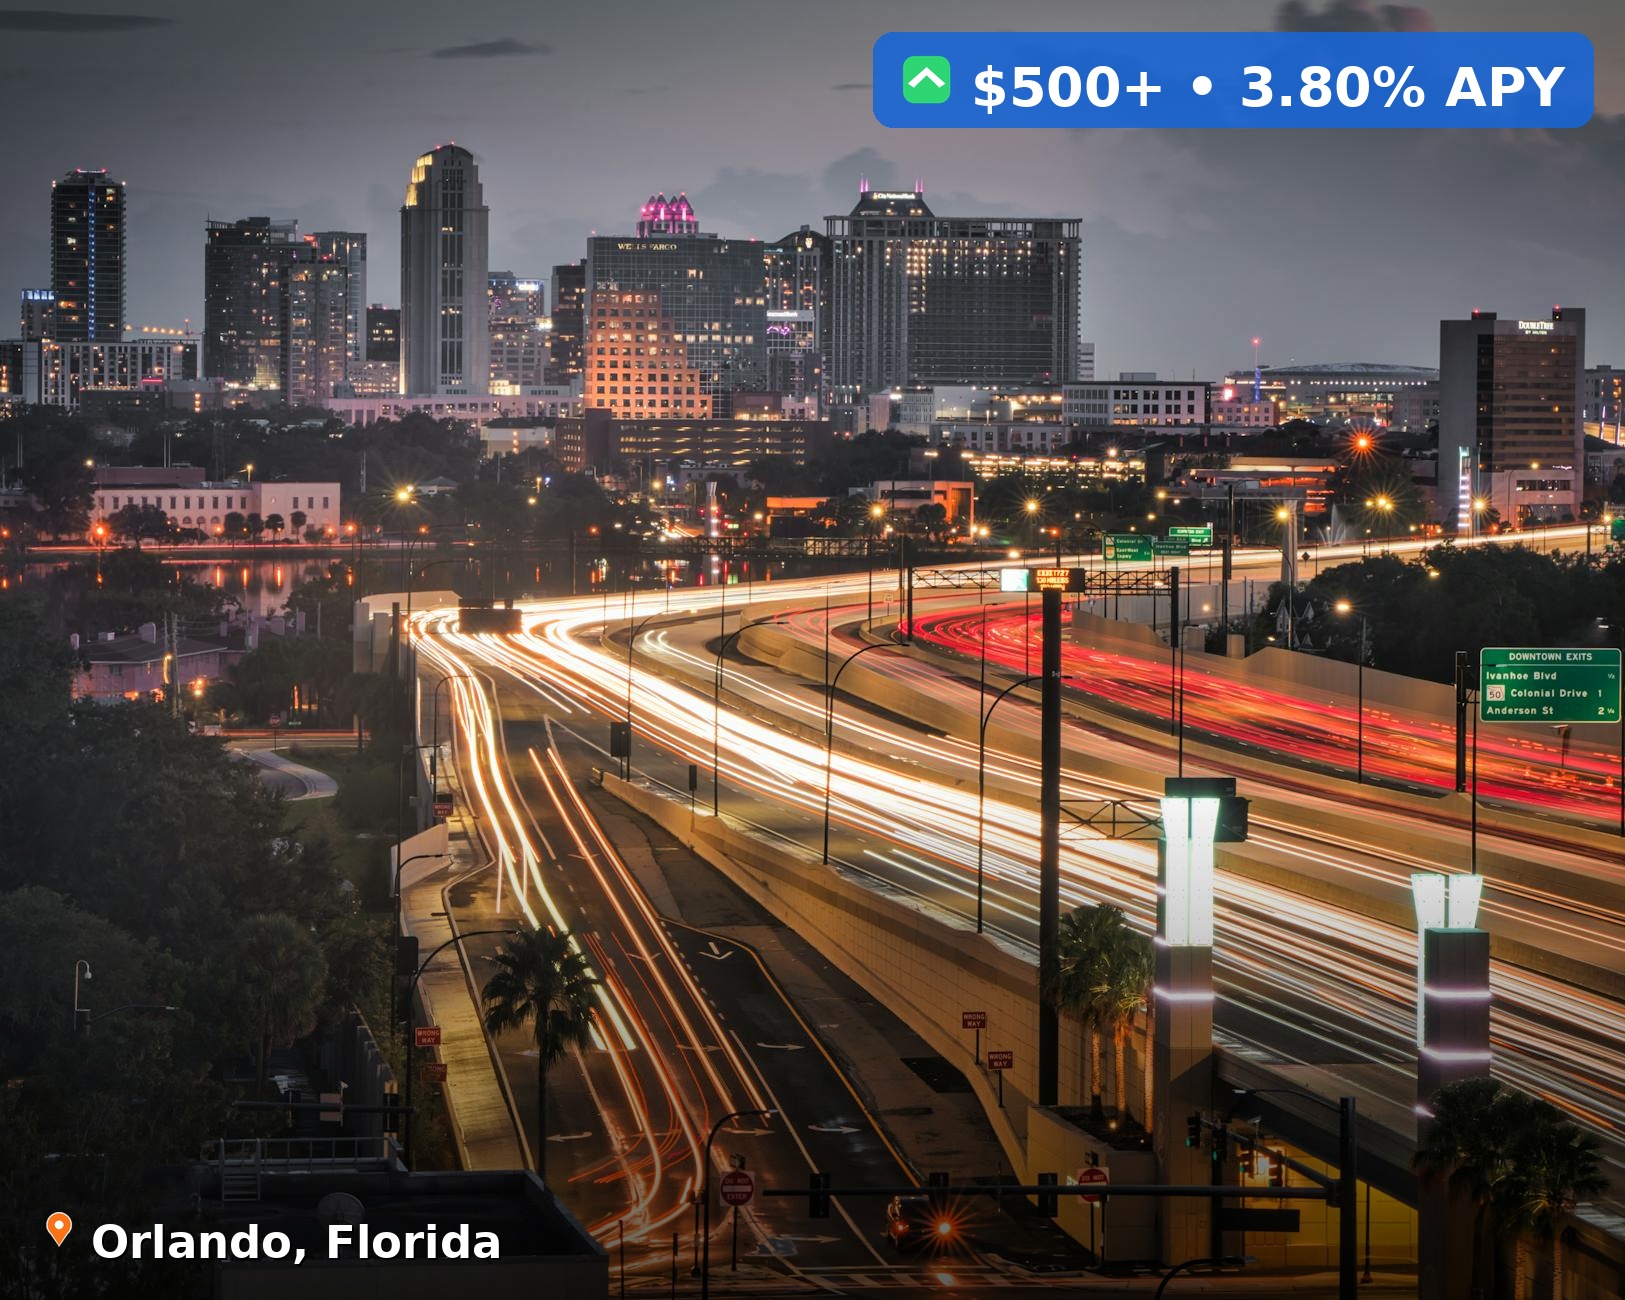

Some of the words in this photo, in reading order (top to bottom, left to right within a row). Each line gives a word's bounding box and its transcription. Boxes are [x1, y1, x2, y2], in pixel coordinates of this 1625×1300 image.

[1509, 653, 1561, 661] DOWNTOWN
[1566, 653, 1593, 661] EXITS
[1486, 671, 1529, 680] Ivanhoe
[1533, 671, 1557, 680] Blvd
[1489, 691, 1501, 699] 50
[1510, 689, 1555, 697] Colonial
[1559, 689, 1588, 697] Drive
[1598, 689, 1602, 698] 1
[1486, 706, 1537, 715] Anderson
[1542, 706, 1554, 715] St
[1598, 706, 1605, 715] 2
